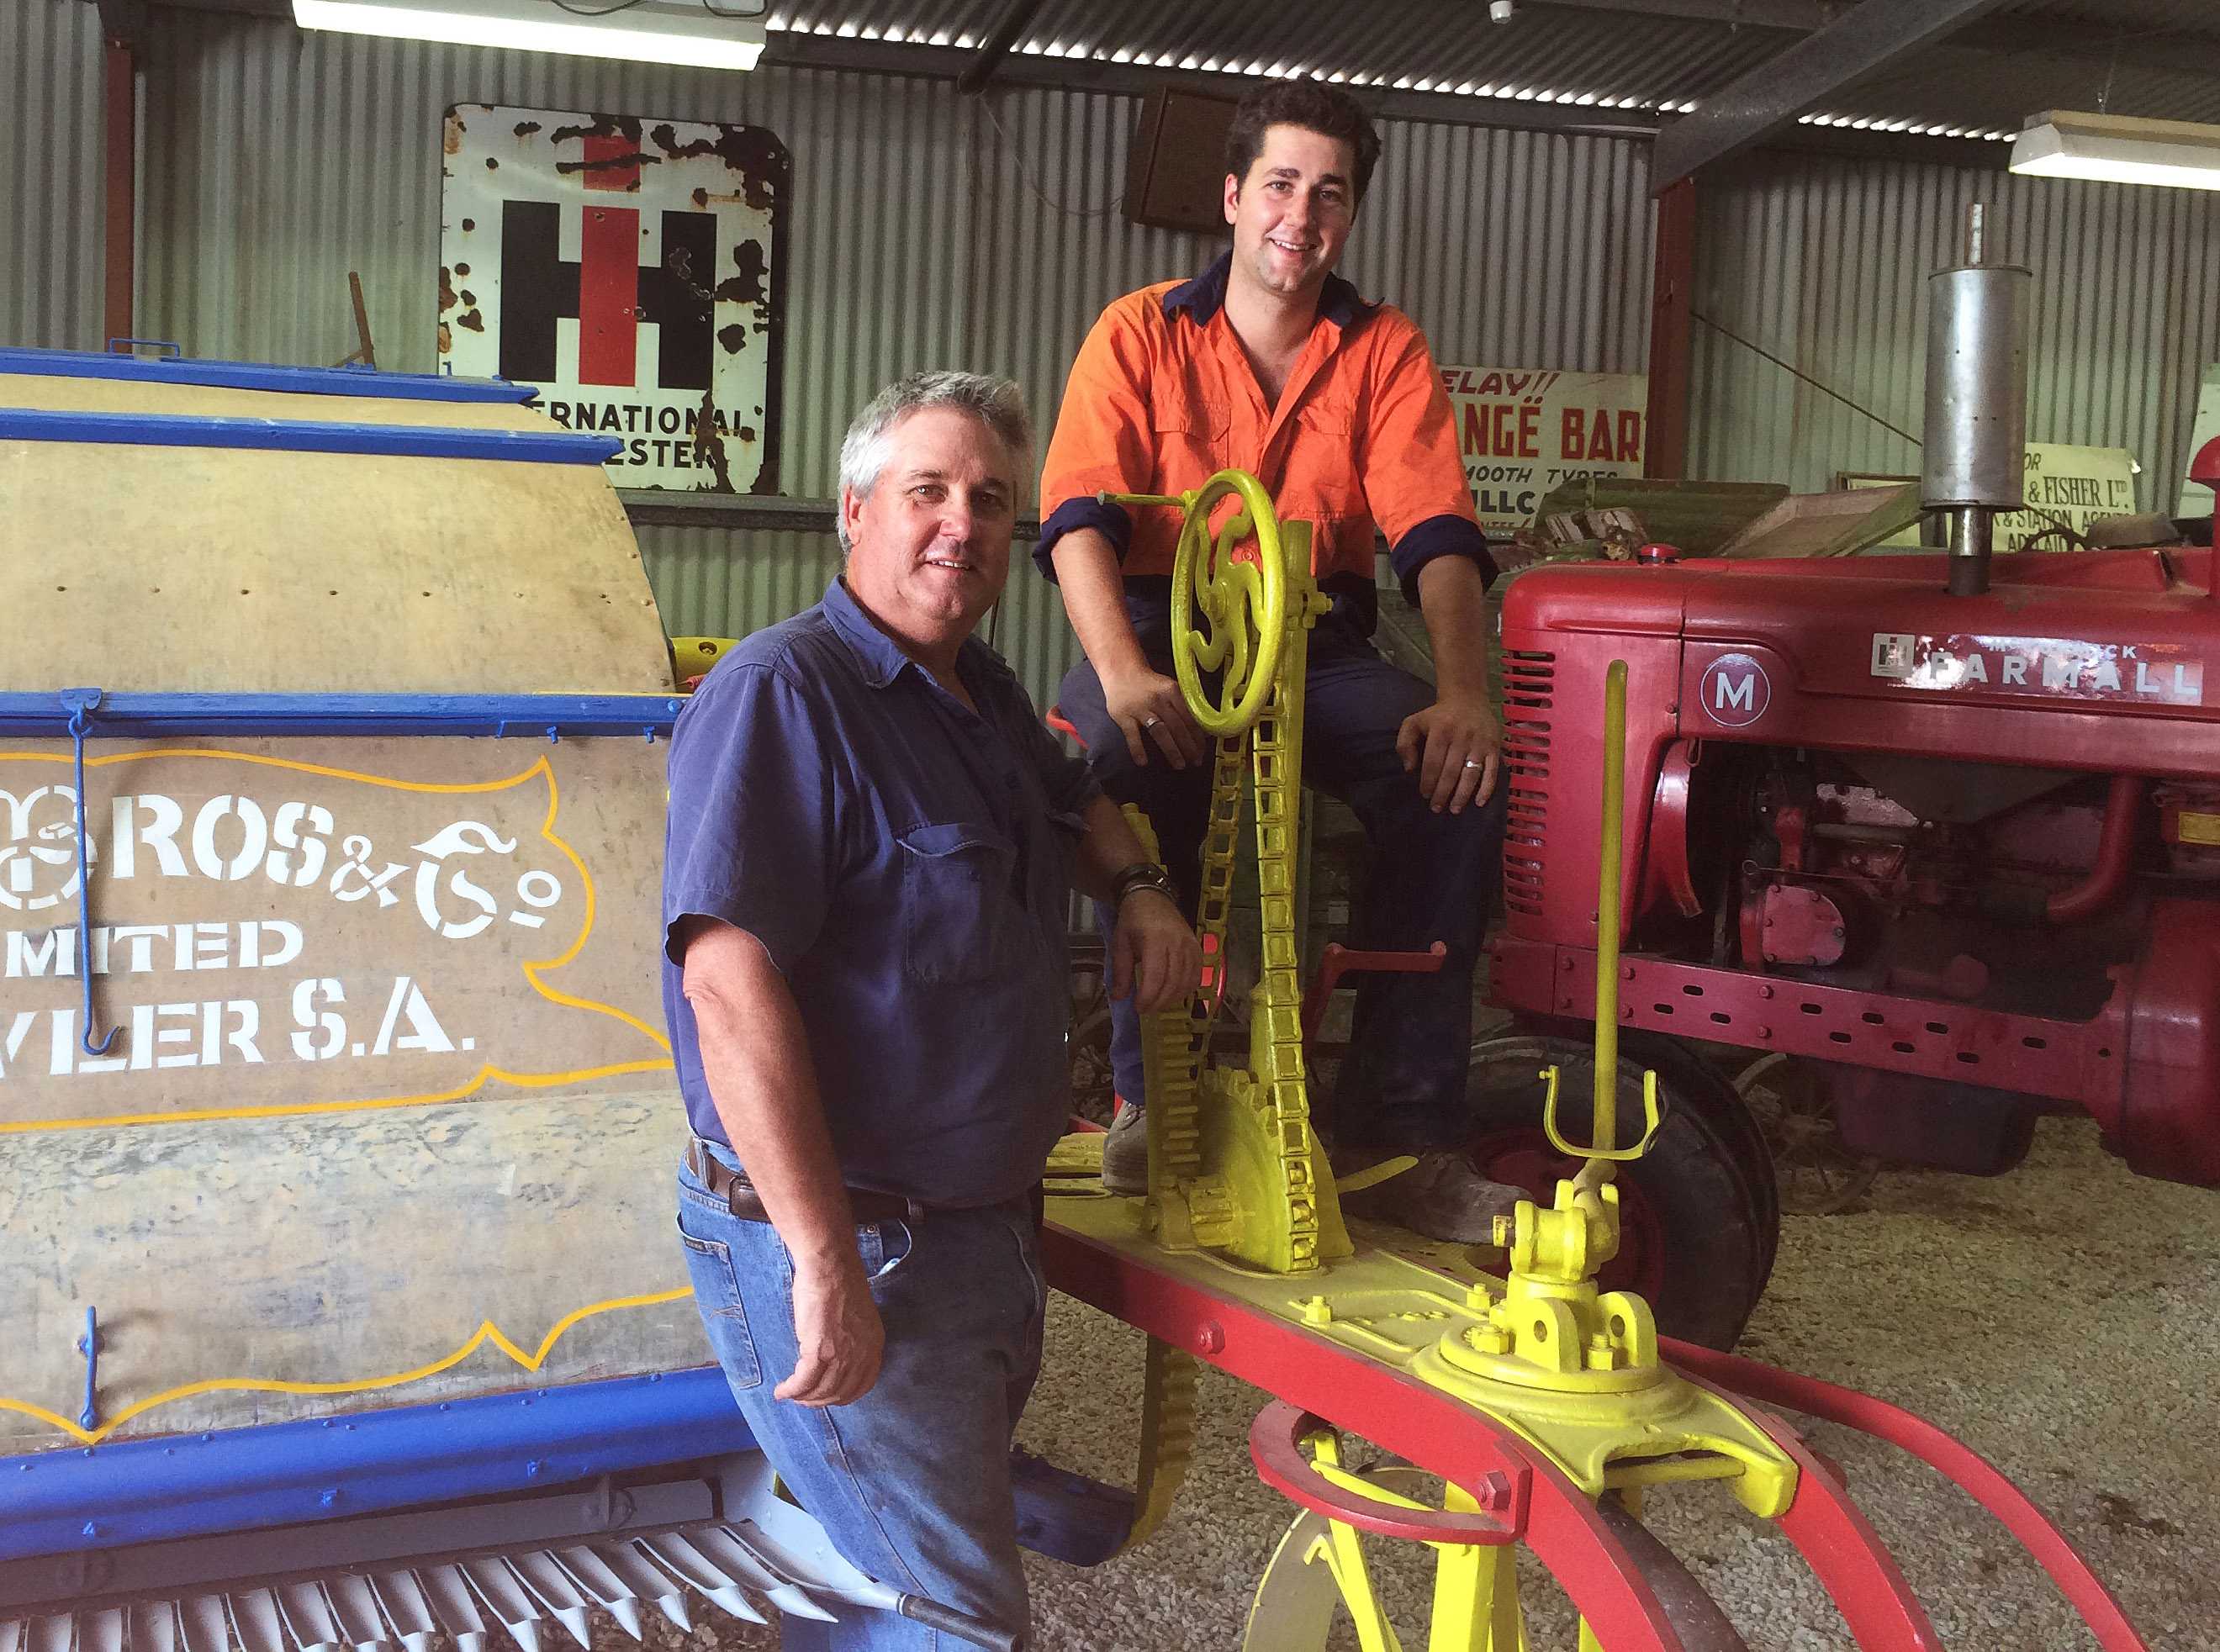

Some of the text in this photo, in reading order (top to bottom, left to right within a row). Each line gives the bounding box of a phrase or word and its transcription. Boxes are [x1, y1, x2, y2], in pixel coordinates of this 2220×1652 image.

[1464, 403, 1641, 462] NGE BAR
[1471, 489, 1547, 515] LLC
[2028, 481, 2040, 504] &
[2043, 476, 2103, 506] FISHER
[2016, 508, 2073, 531] STATION
[1715, 672, 1754, 711] M
[1930, 652, 2200, 696] FARMALL
[330, 835, 410, 908] &
[5, 920, 304, 978] MITED
[290, 976, 475, 1061] S.A.
